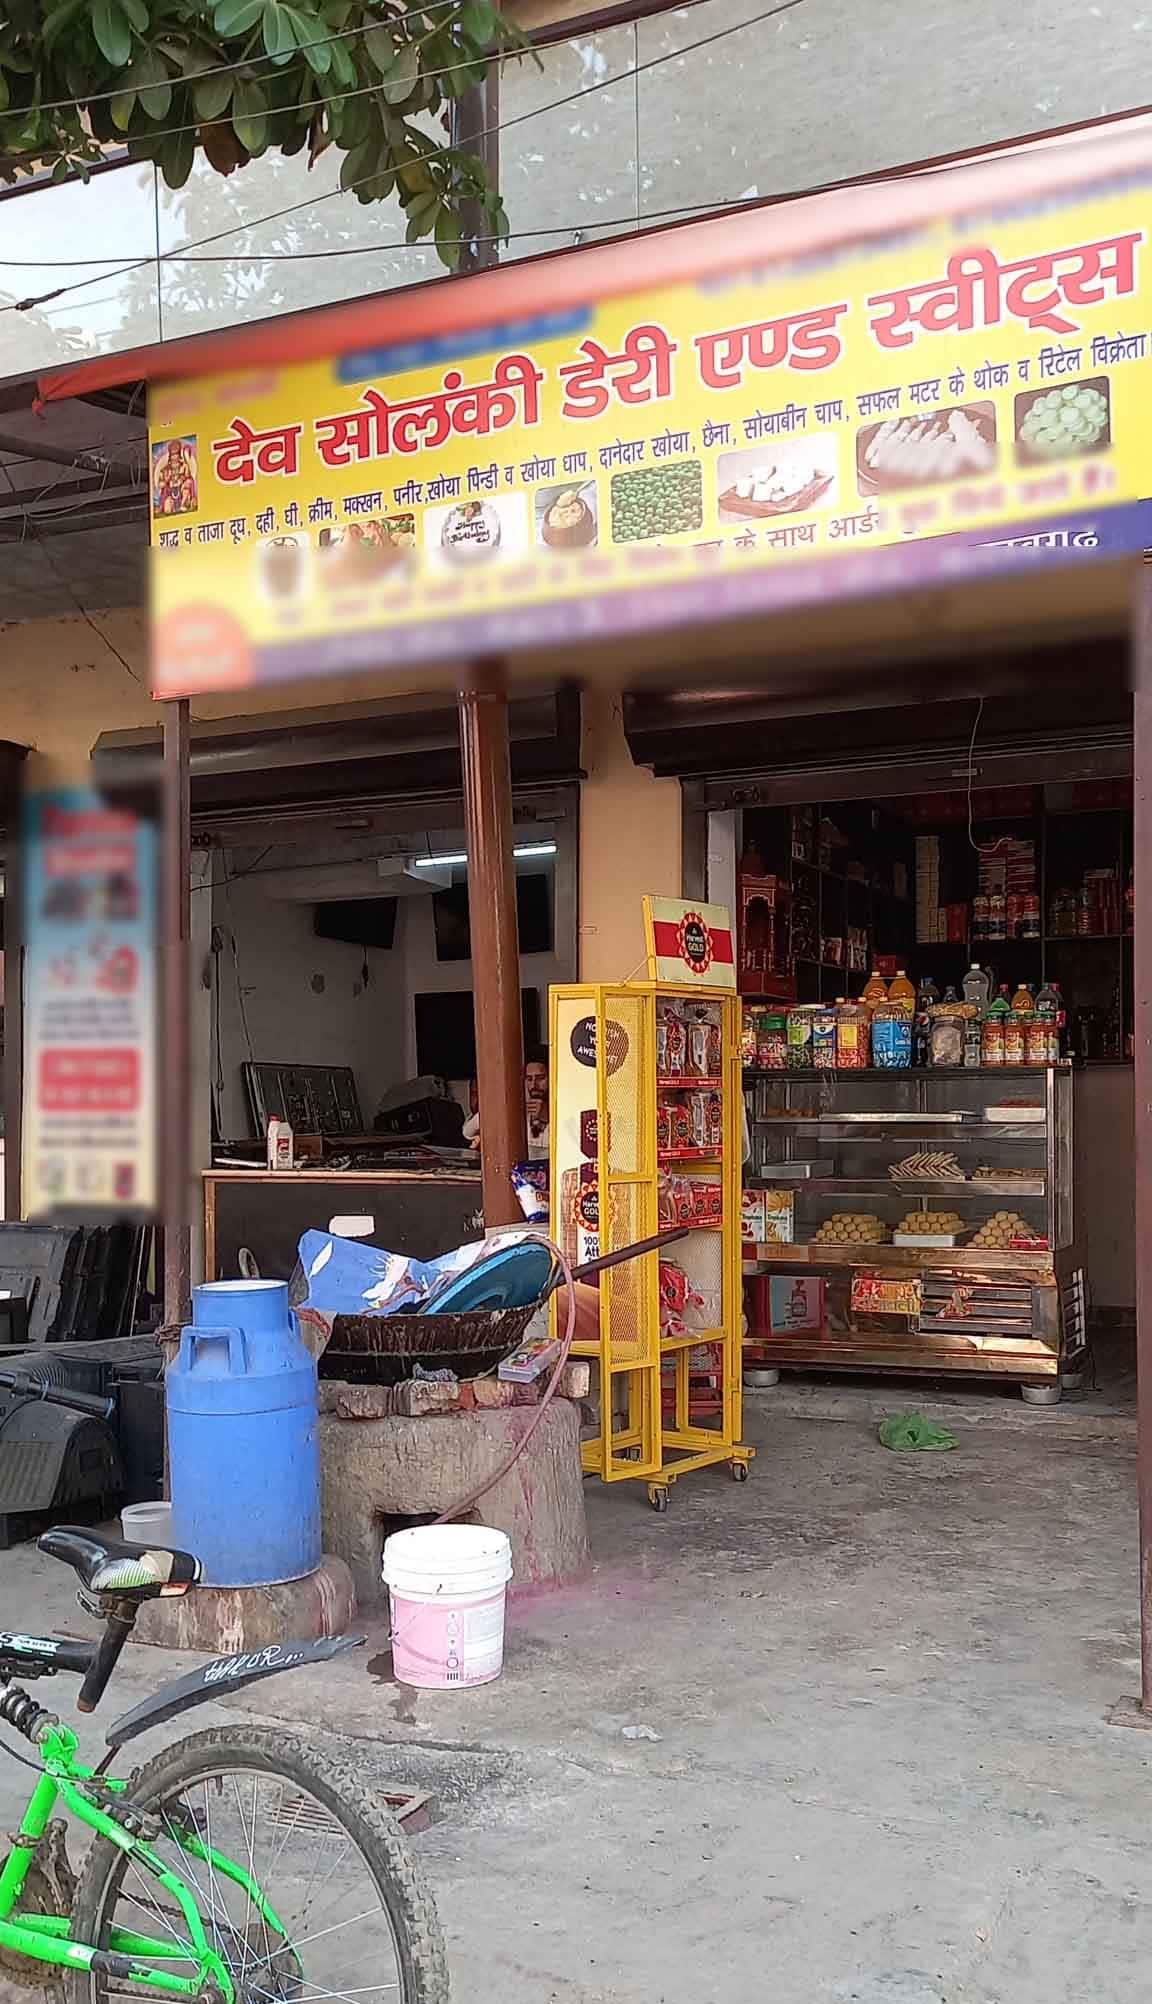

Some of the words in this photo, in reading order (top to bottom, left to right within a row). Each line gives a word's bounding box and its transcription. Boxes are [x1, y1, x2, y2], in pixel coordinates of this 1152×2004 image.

[213, 418, 302, 483] देव
[315, 355, 544, 466] सोलंकी
[559, 325, 678, 418] डेरी
[695, 304, 848, 388] एण्ड
[868, 233, 1142, 347] स्वीट्स
[520, 455, 557, 482] खोया
[743, 403, 807, 439] सोयाबीन
[855, 387, 901, 416] सफल
[908, 377, 942, 405] मटर
[948, 366, 966, 396] के
[974, 359, 1010, 391] थोक
[1018, 359, 1030, 382] व
[829, 504, 880, 539] आर्ड
